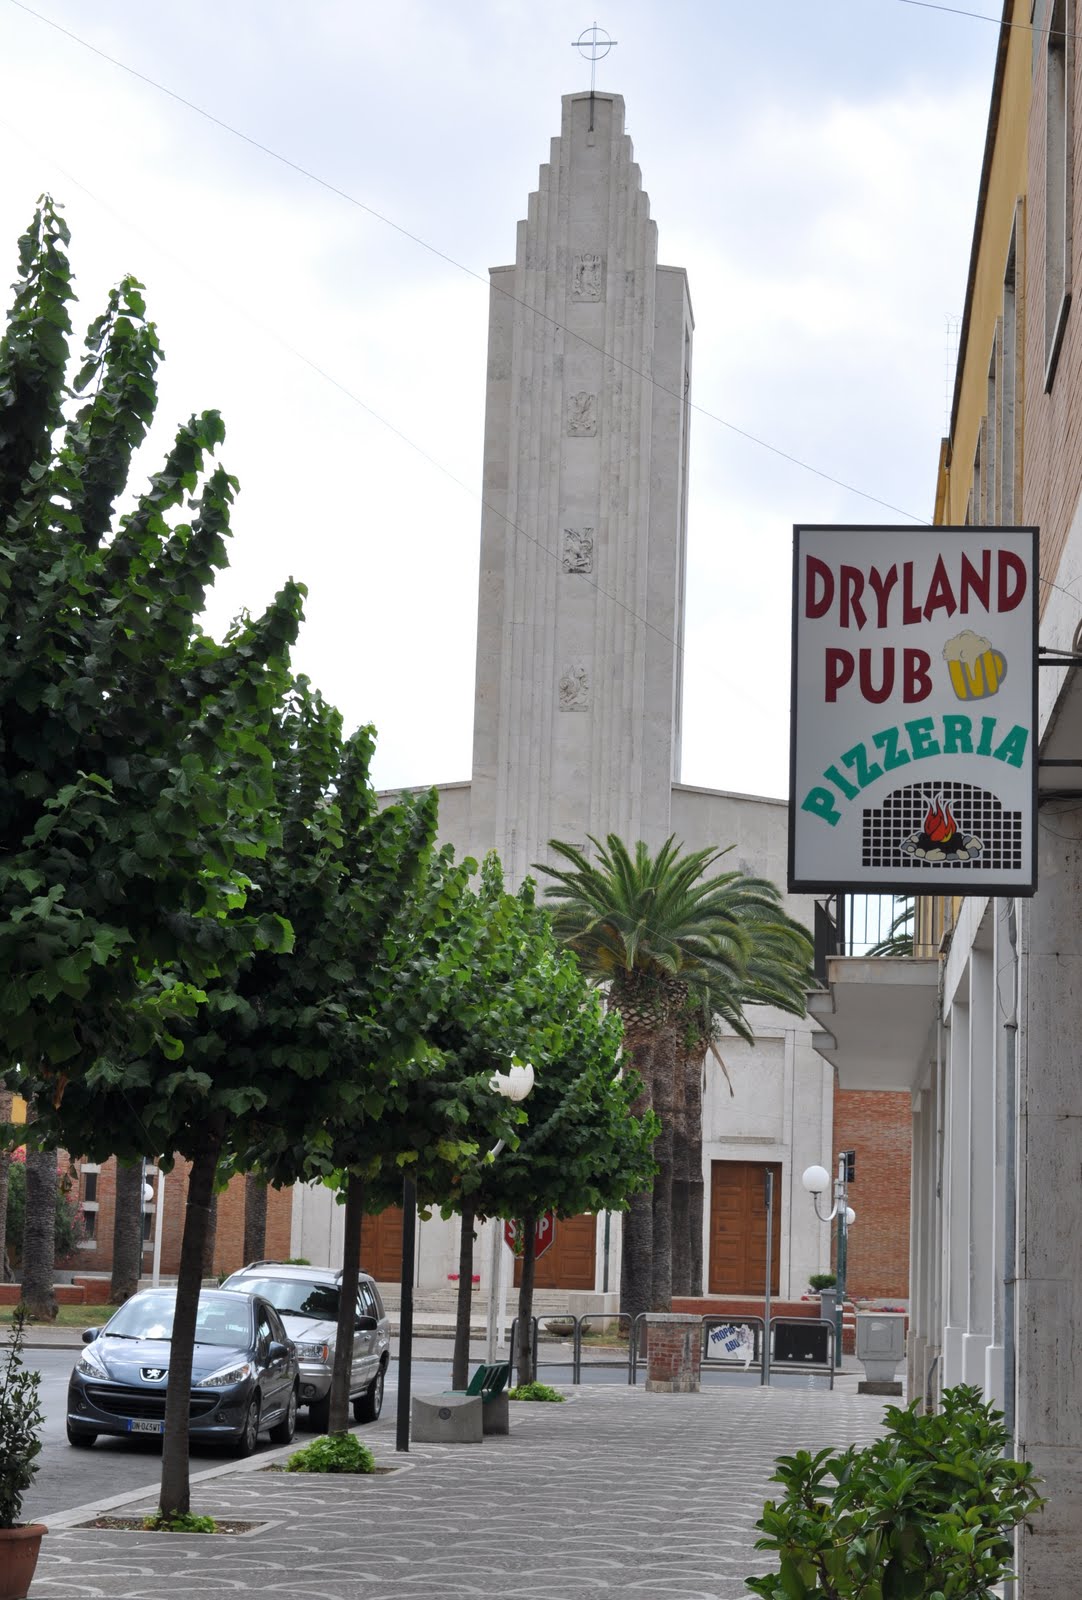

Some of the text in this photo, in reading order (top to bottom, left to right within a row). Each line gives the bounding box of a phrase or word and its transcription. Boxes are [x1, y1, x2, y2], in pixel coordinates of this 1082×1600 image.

[805, 549, 1027, 631] DRYLAND
[825, 647, 933, 704] PUB
[801, 714, 1029, 827] PIZZERIA
[508, 1217, 549, 1239] SP
